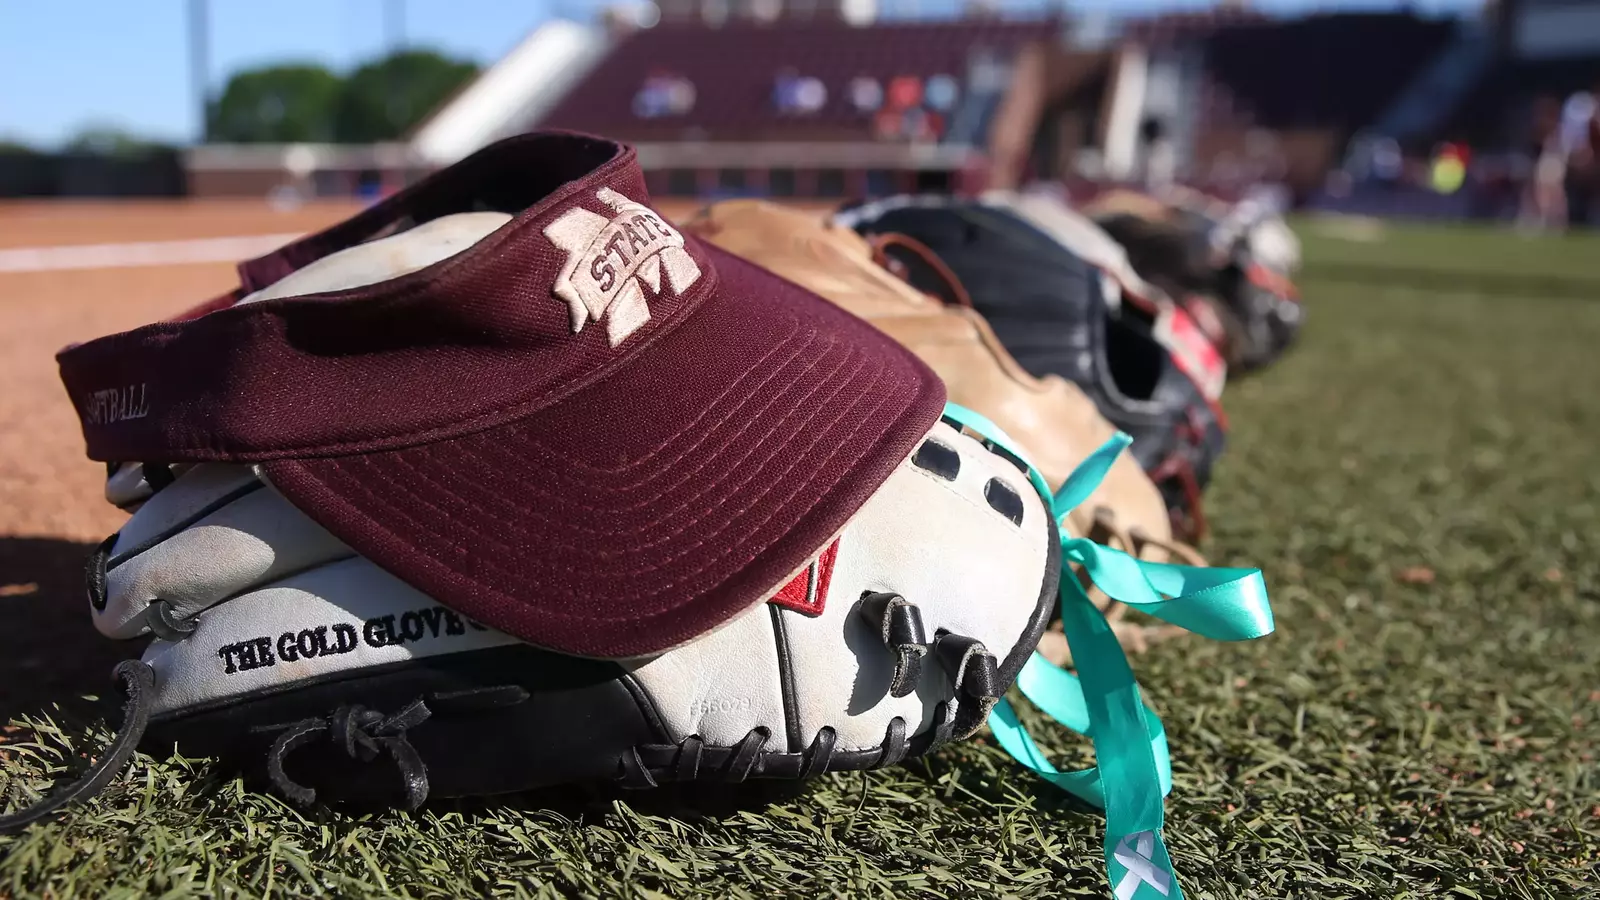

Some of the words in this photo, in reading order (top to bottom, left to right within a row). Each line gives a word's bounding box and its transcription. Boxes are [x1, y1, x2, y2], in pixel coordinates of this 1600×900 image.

[590, 214, 671, 292] STATE
[218, 636, 276, 674] THE
[276, 623, 358, 663] GOLD
[362, 606, 466, 648] GLOVE
